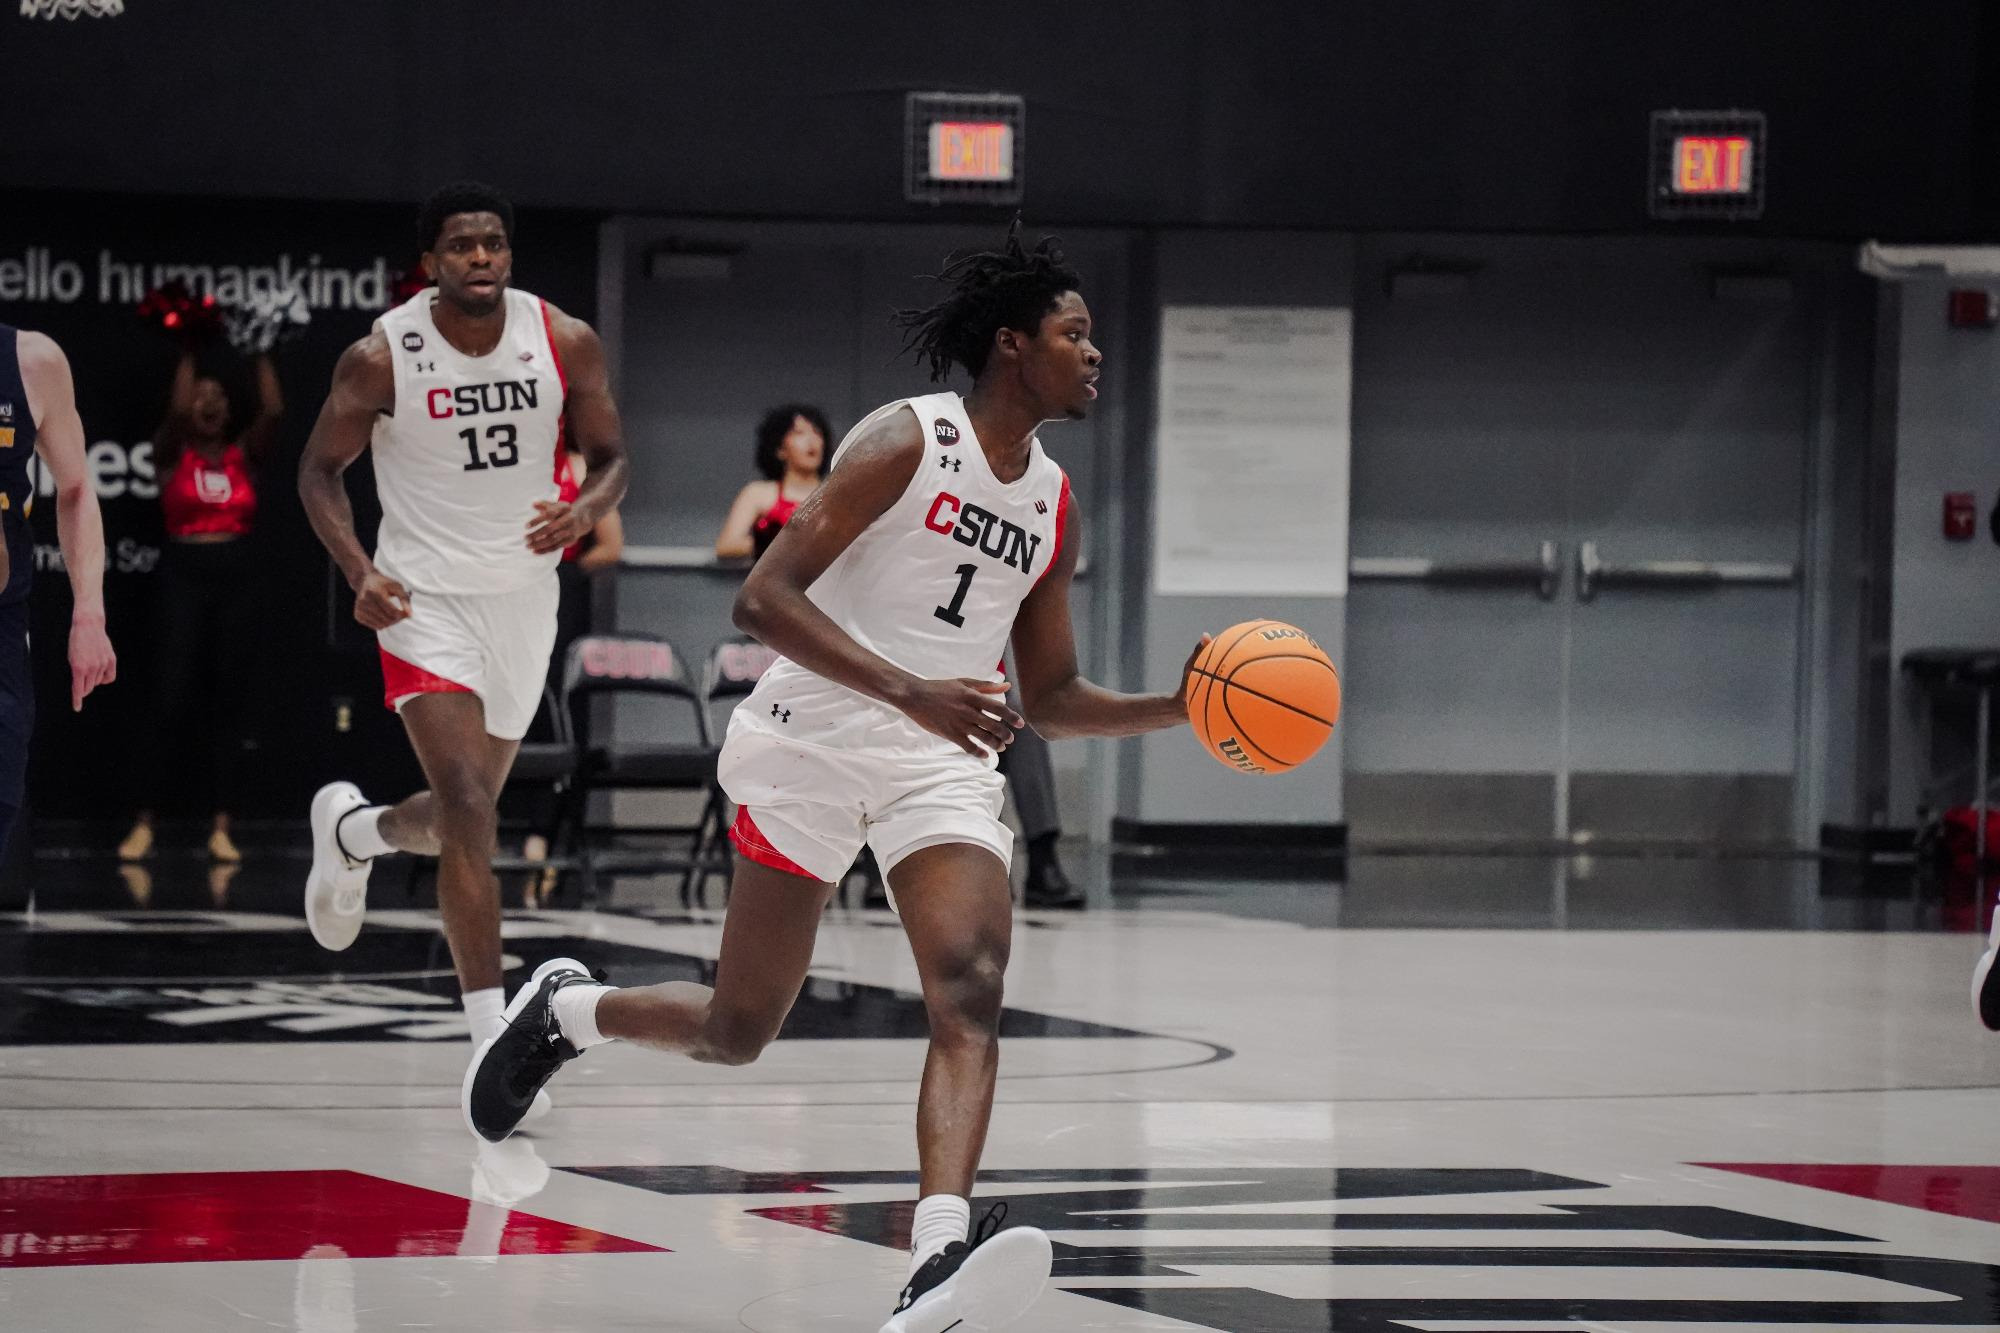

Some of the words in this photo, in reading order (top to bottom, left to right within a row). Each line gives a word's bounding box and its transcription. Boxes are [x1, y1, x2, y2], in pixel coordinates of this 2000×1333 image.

[427, 379, 538, 419] CSUN
[459, 424, 519, 471] 13
[935, 425, 957, 439] NH
[924, 491, 1041, 575] CSUN
[933, 563, 978, 629] 1
